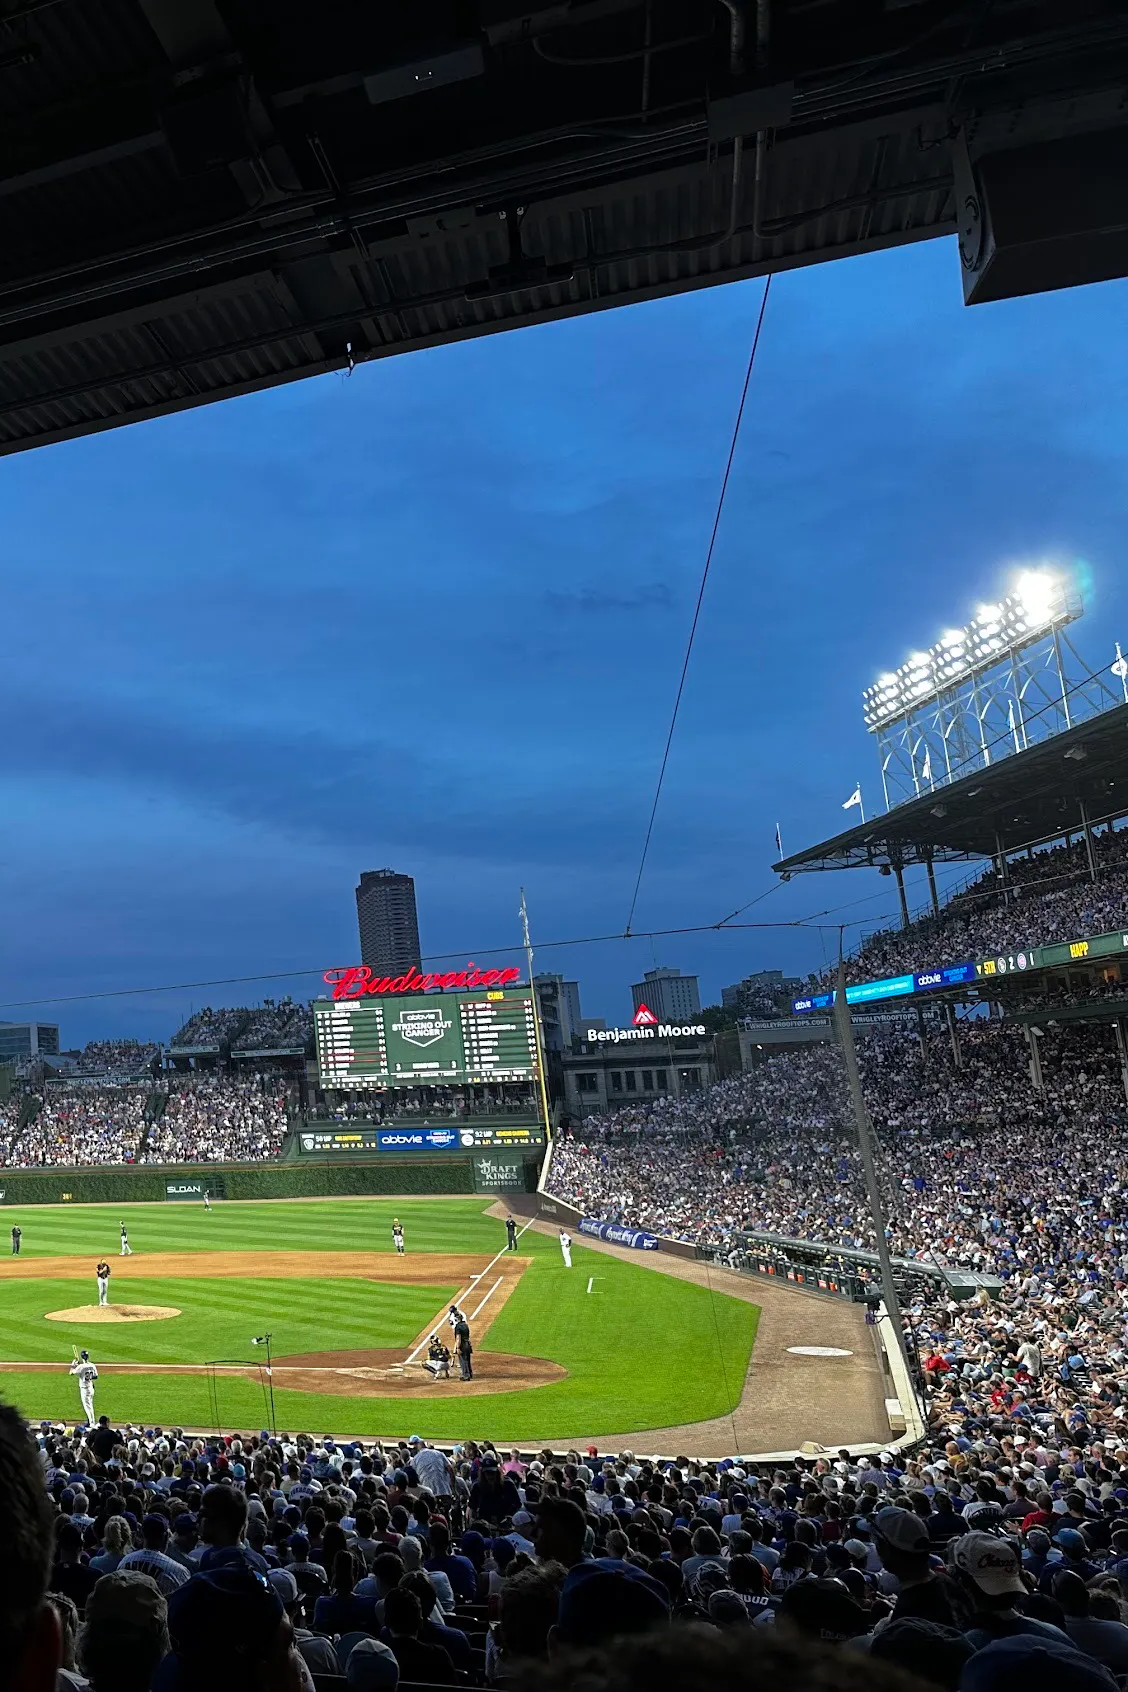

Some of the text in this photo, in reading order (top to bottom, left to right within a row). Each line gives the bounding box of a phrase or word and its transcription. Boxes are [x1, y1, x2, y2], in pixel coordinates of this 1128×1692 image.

[1069, 941, 1089, 958] HAPP
[984, 960, 996, 975] 5TH
[1008, 956, 1015, 970] 2
[324, 961, 522, 999] Budweiser
[918, 973, 941, 986] abbvie
[487, 991, 504, 1001] CUBS
[794, 999, 812, 1011] abbvie
[407, 1013, 436, 1022] abbvie
[391, 1020, 453, 1032] STRIKING OUT
[405, 1028, 441, 1038] CANCER
[587, 1024, 707, 1044] Benjamin Moore
[381, 1133, 423, 1145] abbvie
[480, 1164, 518, 1175] DRAFT
[485, 1172, 518, 1180] KINGS
[166, 1185, 202, 1194] SLOAN
